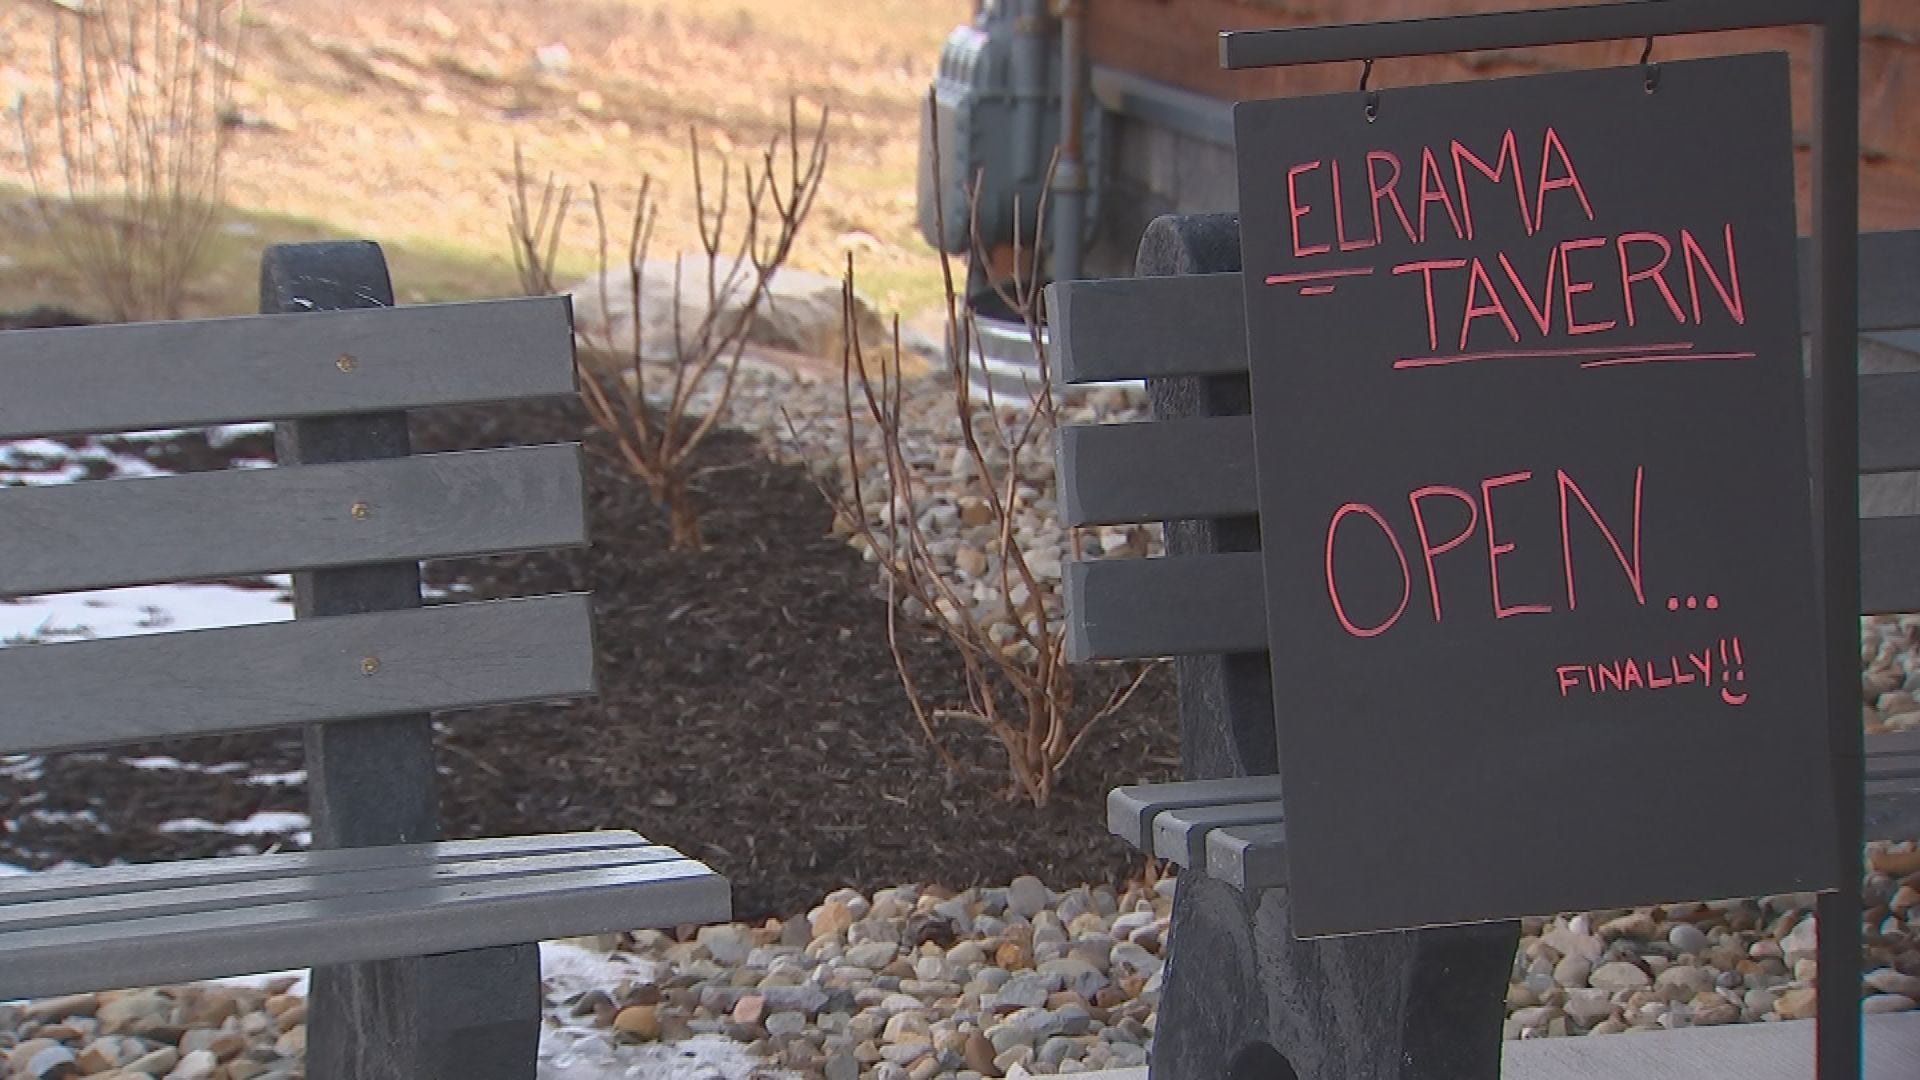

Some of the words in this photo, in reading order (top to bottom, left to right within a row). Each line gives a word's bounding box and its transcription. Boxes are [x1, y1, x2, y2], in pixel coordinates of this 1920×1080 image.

[1287, 127, 1594, 258] ELRAMA
[1392, 223, 1745, 351] TAVERN
[1325, 467, 1720, 638] OPEN...
[1556, 637, 1744, 694] FINALLY!!
